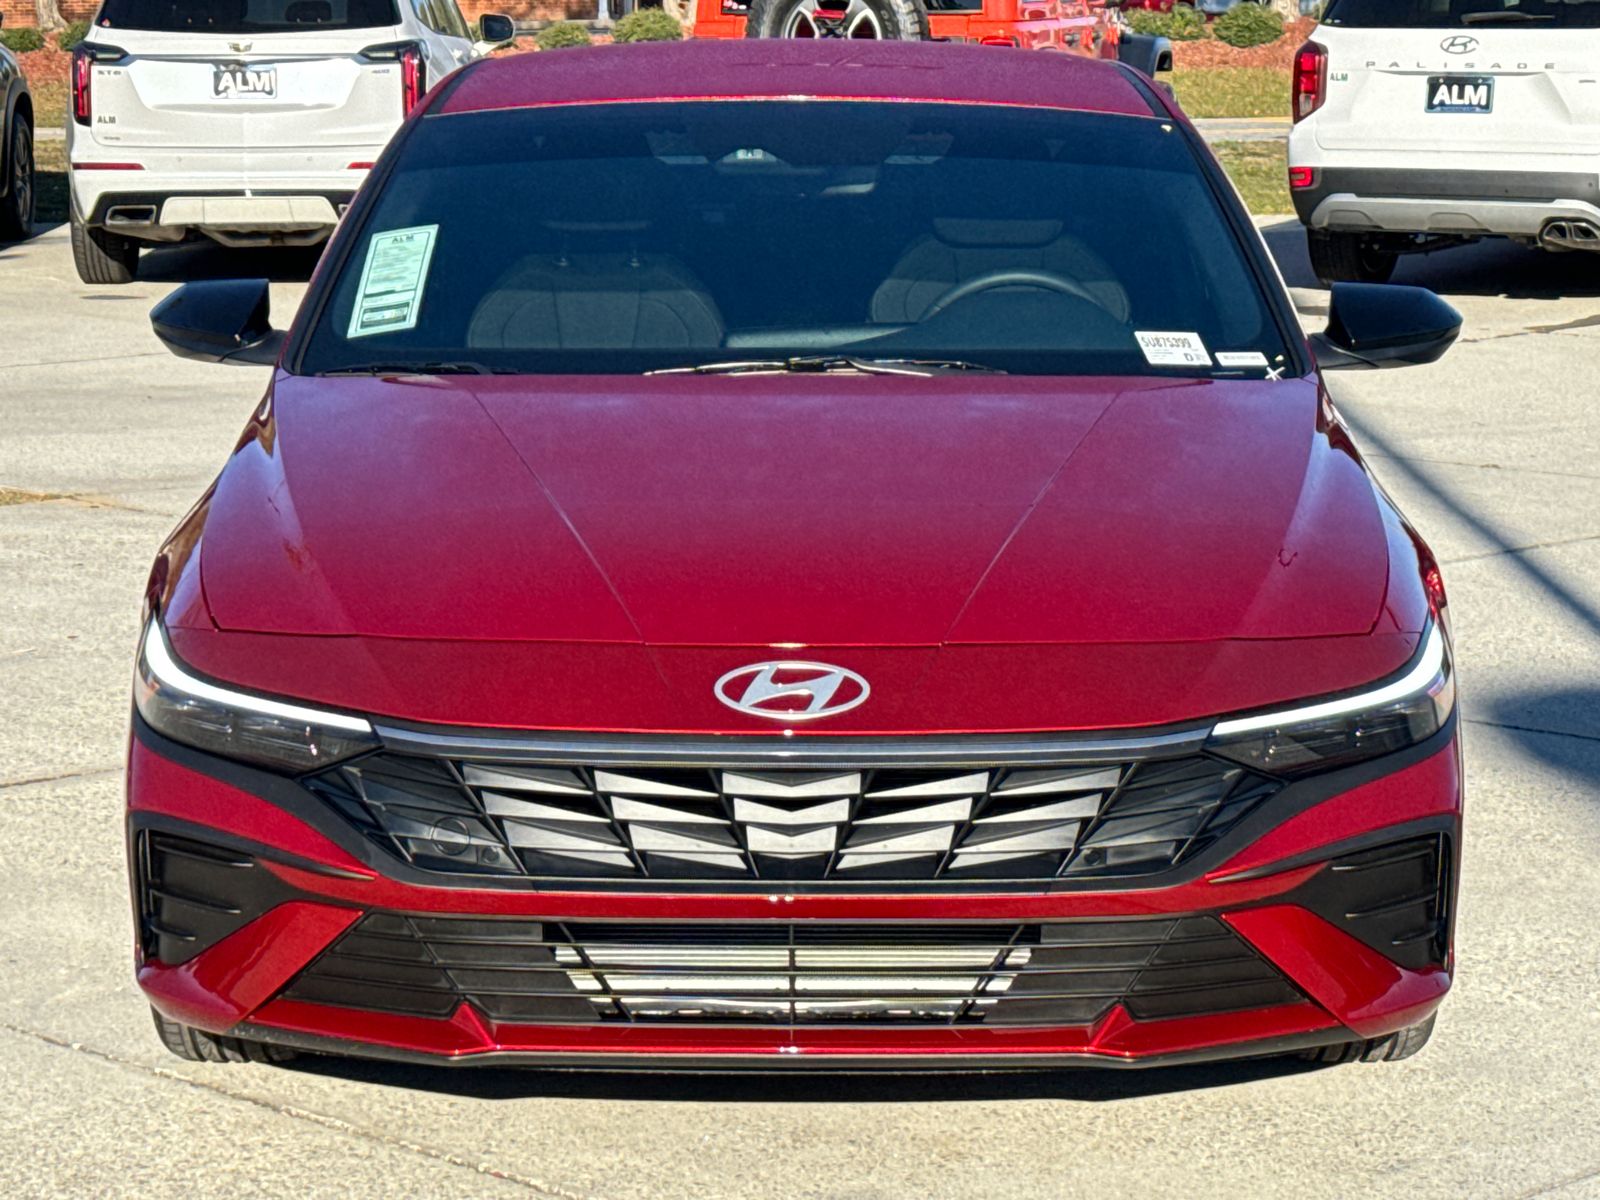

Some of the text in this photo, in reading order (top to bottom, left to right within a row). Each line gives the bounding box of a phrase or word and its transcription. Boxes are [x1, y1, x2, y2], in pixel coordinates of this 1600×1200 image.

[1365, 61, 1556, 69] PALISADE
[217, 71, 273, 93] ALM
[1330, 73, 1349, 82] ALM
[1432, 84, 1488, 106] ALM
[97, 115, 116, 124] ALM
